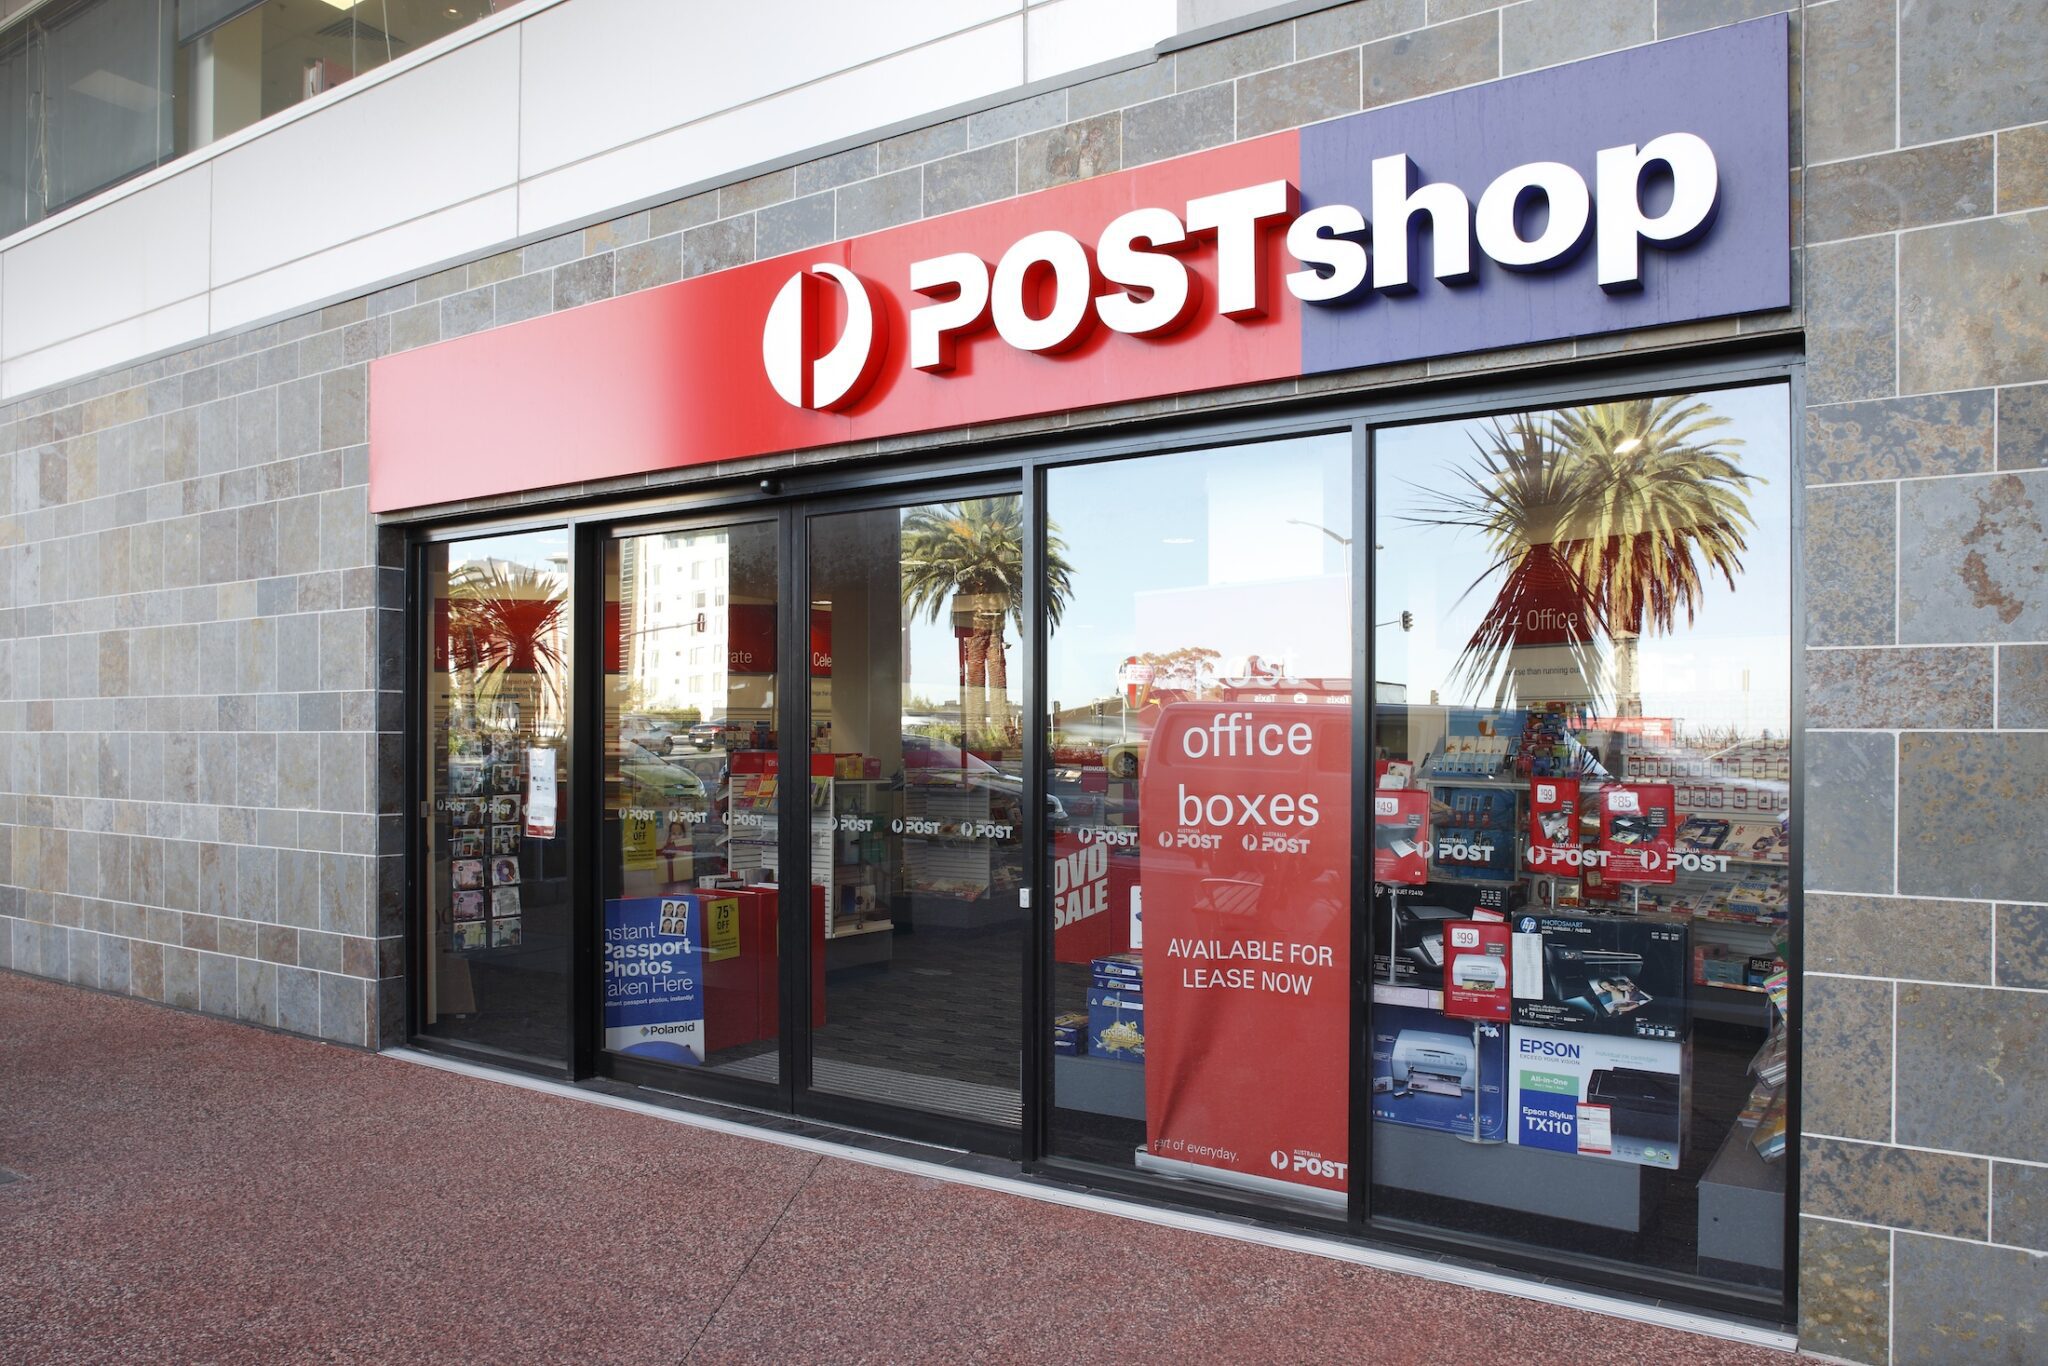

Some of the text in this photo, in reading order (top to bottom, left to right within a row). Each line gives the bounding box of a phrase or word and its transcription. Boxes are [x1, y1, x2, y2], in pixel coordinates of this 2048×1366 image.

[910, 132, 1718, 370] POSTshop
[1527, 608, 1578, 631] Office
[1183, 712, 1313, 759] office
[1540, 788, 1553, 801] $99
[1613, 795, 1632, 808] $85
[445, 801, 466, 812] POST
[489, 803, 512, 815] POST
[1178, 784, 1320, 827] boxes
[1376, 801, 1393, 813] $49
[629, 810, 655, 820] POST
[680, 812, 708, 824] POST
[734, 814, 763, 826] POST
[841, 819, 873, 832] POST
[906, 822, 941, 835] POST
[976, 824, 1013, 839] POST
[1095, 831, 1138, 846] POST
[1177, 833, 1223, 849] POST
[1262, 837, 1311, 854] POST
[1439, 843, 1495, 861] POST
[1551, 848, 1611, 867] POST
[1667, 846, 1701, 854] AUSTRALIA
[1055, 841, 1108, 897] DVD
[1667, 853, 1732, 873] POST
[1055, 877, 1109, 931] SALE
[605, 922, 655, 940] nstant
[1520, 917, 1537, 933] hp
[1457, 932, 1474, 944] $99
[605, 938, 691, 960] Passport
[1167, 938, 1333, 967] AVAILABLE FOR
[605, 959, 672, 977] Photos
[605, 975, 693, 997] aken Here
[1182, 968, 1313, 996] LEASE NOW
[623, 998, 648, 1007] passport
[650, 1022, 695, 1035] Polaroid
[1520, 1038, 1580, 1059] EPSON
[1519, 1054, 1580, 1066] EXCEED YOUR VISION
[1530, 1074, 1568, 1087] All-in-One
[1523, 1106, 1574, 1122] Epson Stylus
[1525, 1116, 1572, 1136] TX110
[1154, 1138, 1240, 1163] part of everyday.
[1294, 1149, 1322, 1158] AUSTRALIA
[1294, 1155, 1348, 1180] POST
